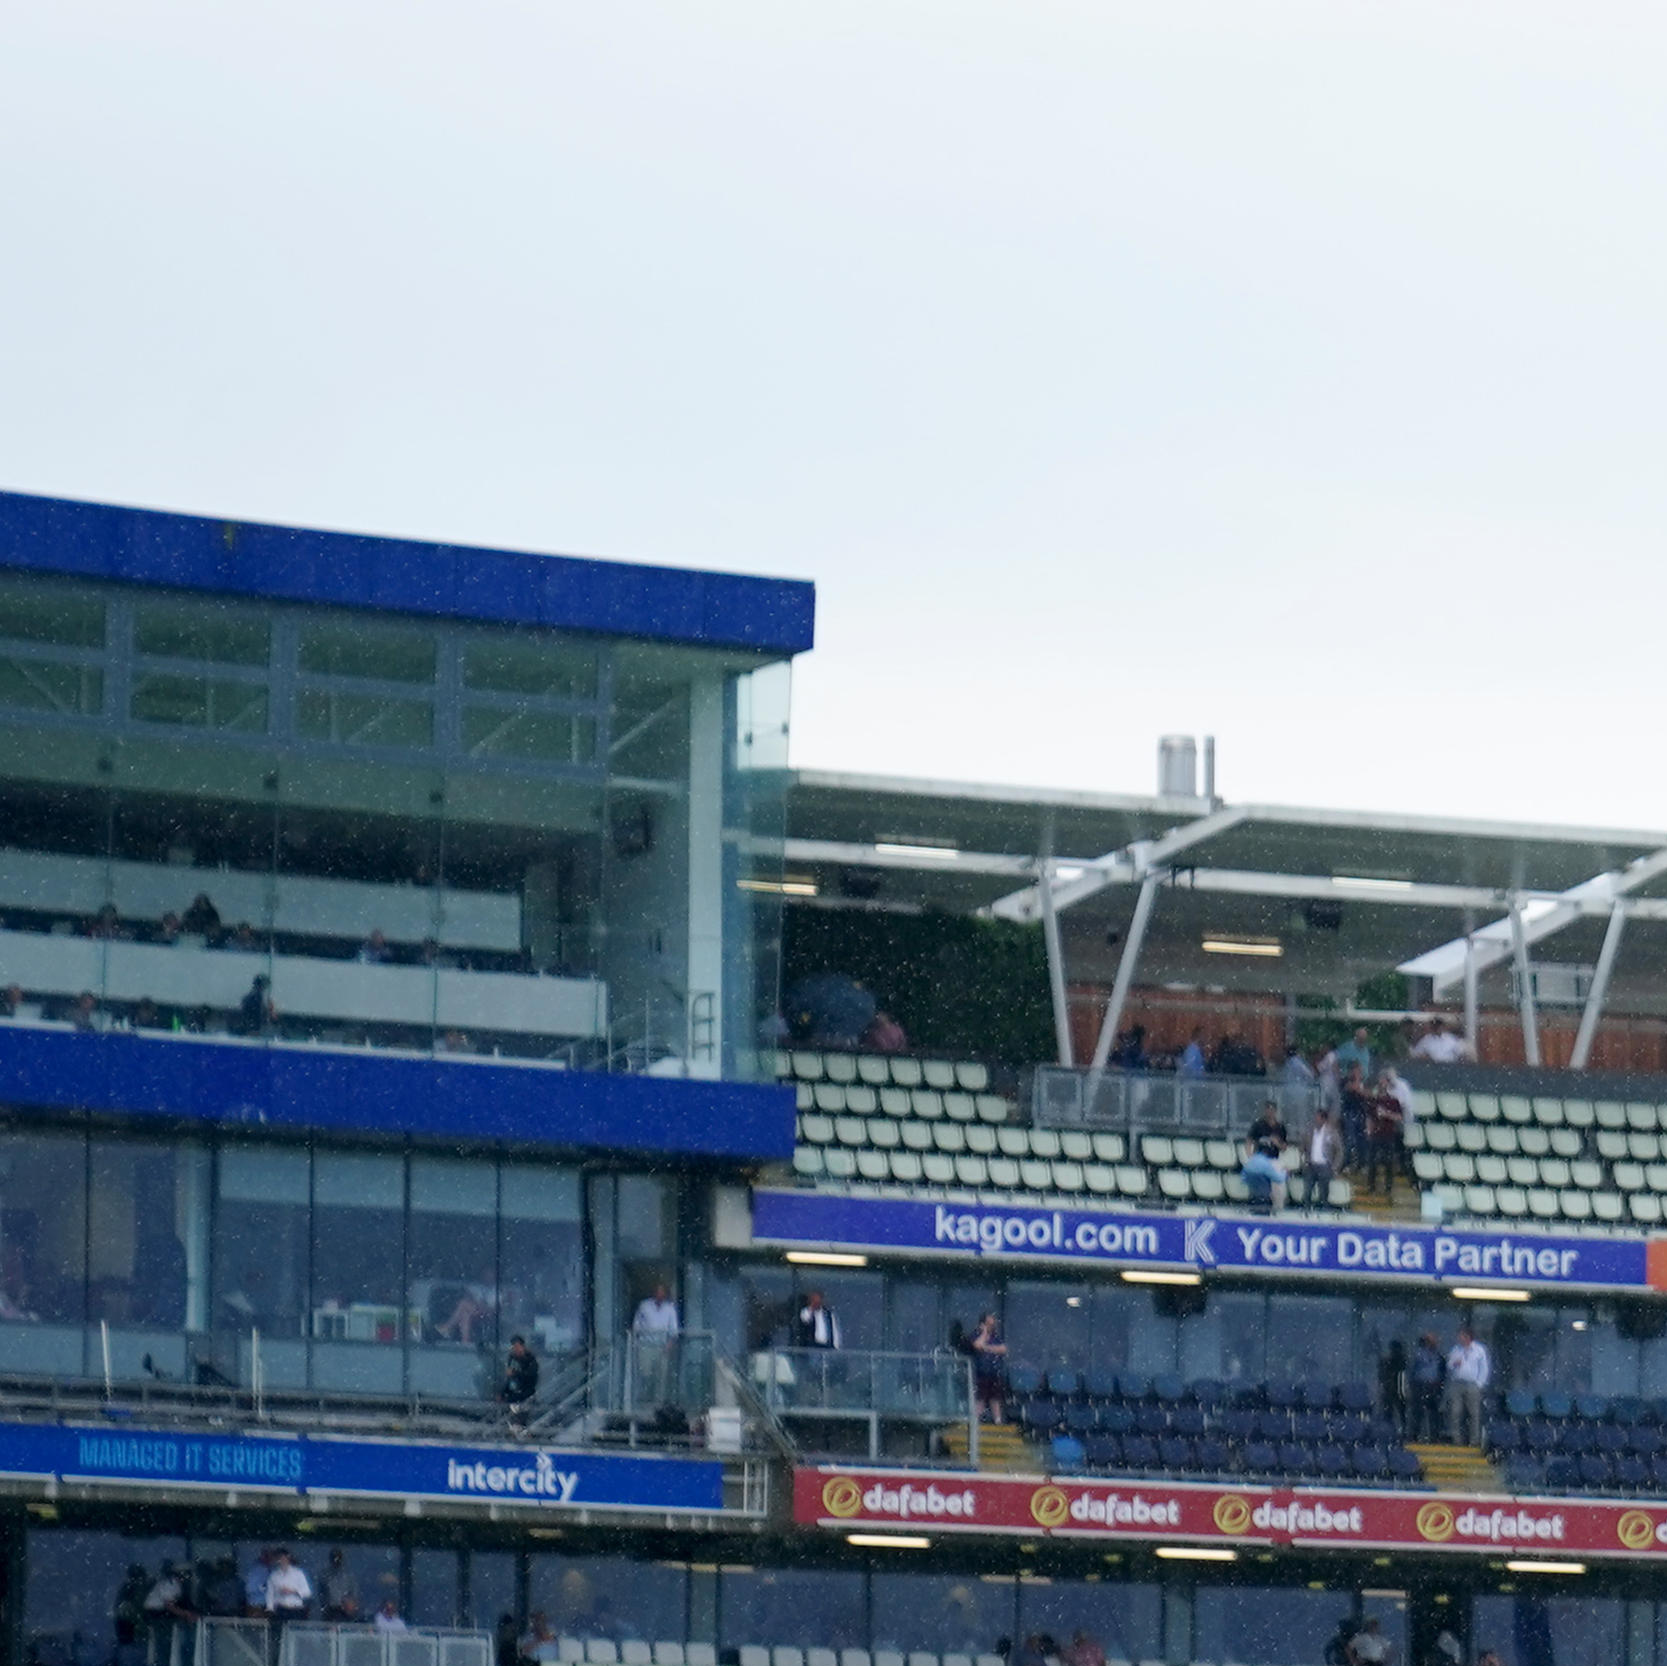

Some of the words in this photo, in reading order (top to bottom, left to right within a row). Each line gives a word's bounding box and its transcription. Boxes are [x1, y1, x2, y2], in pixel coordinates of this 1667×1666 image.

[934, 1205, 1158, 1253] kagool.com
[1237, 1227, 1326, 1264] Your
[1338, 1233, 1422, 1269] Data
[1435, 1242, 1578, 1277] Partner
[79, 1435, 177, 1473] MANAGED
[185, 1440, 204, 1474] IT
[208, 1443, 301, 1479] SERVICES
[448, 1456, 578, 1501] intercity
[863, 1483, 975, 1518] dafabet
[1070, 1494, 1179, 1526] dafabet
[1252, 1502, 1362, 1533] dafabet
[1456, 1508, 1564, 1541] dafabet
